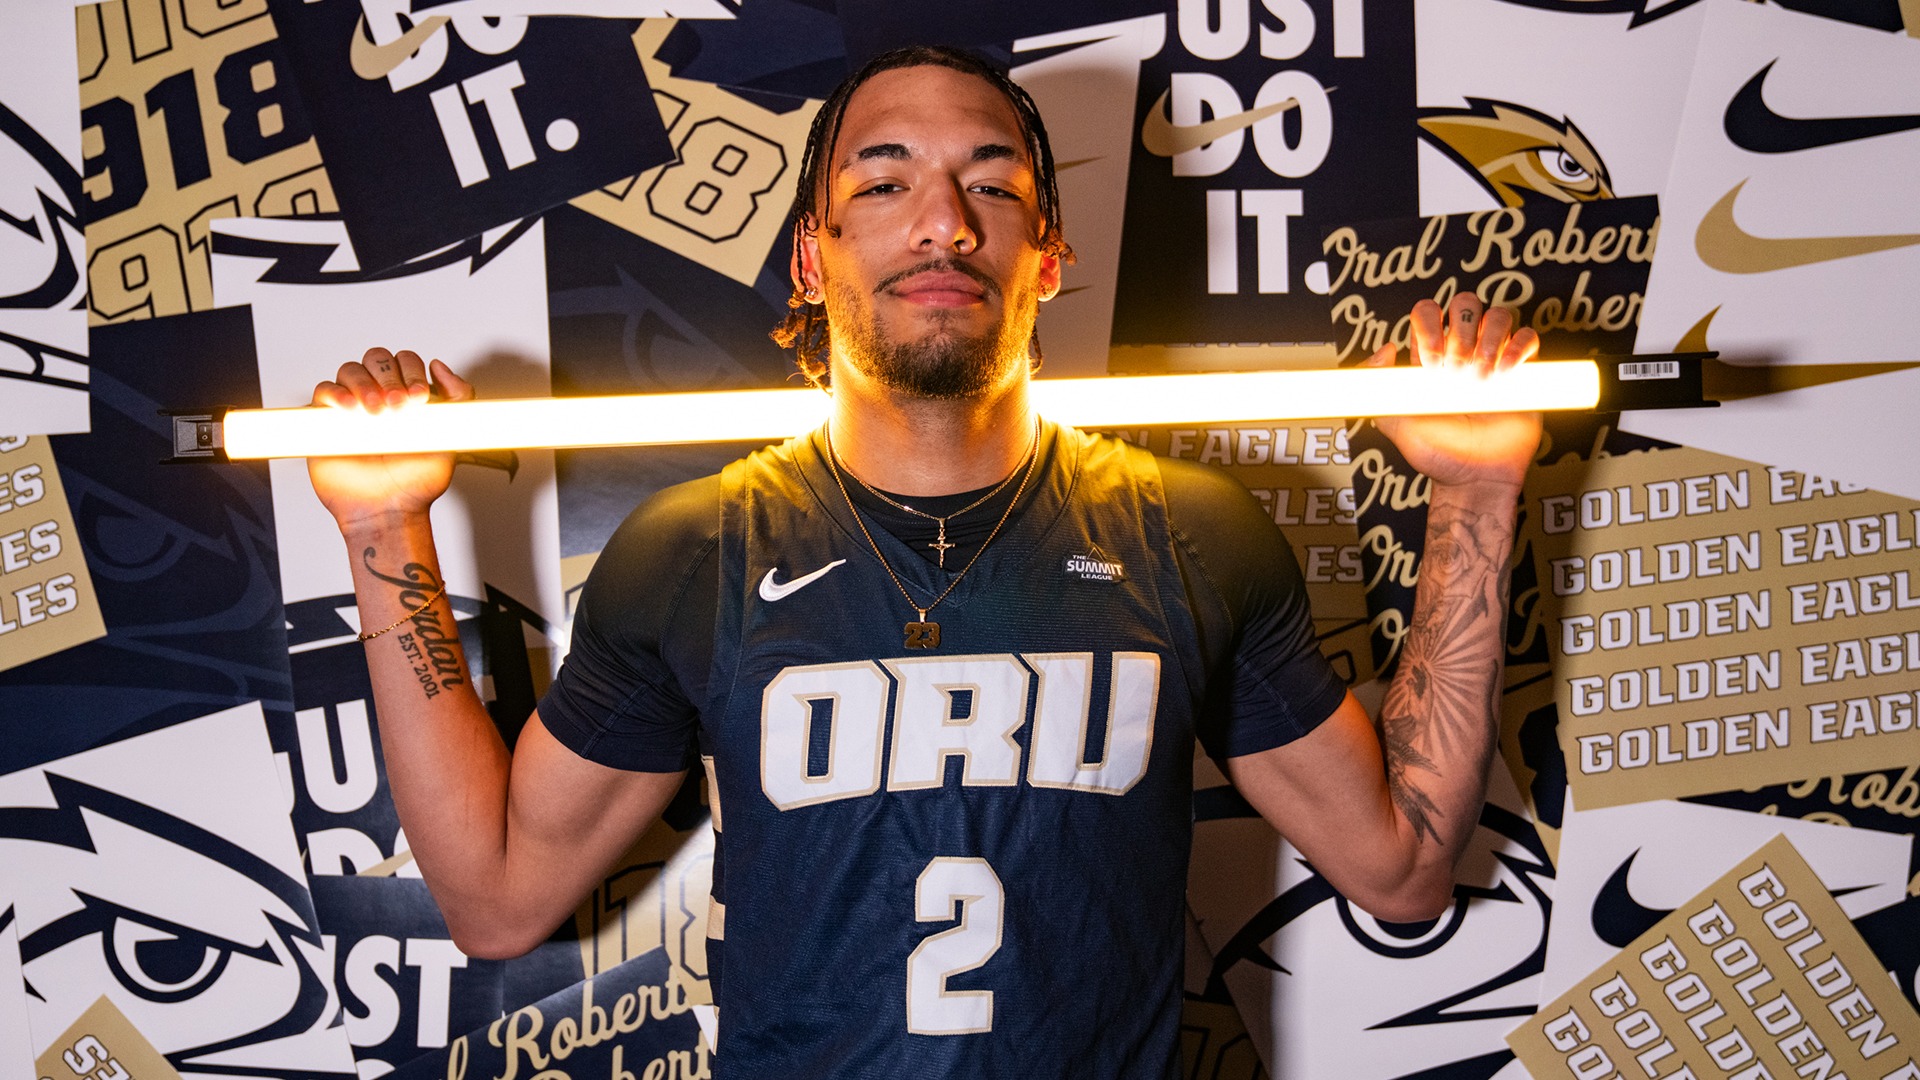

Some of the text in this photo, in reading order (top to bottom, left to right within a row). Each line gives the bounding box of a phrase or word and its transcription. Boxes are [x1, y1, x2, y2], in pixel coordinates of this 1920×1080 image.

[82, 43, 313, 225] 918
[429, 60, 579, 188] IT.
[1171, 70, 1333, 178] DO
[1323, 214, 1451, 295] Oral
[1539, 469, 1749, 535] GOLDEN
[1066, 560, 1123, 576] SUMMIT
[1549, 508, 1920, 597] GOLDEN EAGL
[363, 547, 464, 691] Jordan
[904, 622, 941, 649] 23
[1558, 588, 1772, 656] GOLDEN
[398, 632, 440, 699] EST. 2001
[1567, 650, 1781, 717] GOLDEN
[761, 652, 1161, 811] ORU
[1576, 708, 1790, 776] GOLDEN
[1806, 689, 1920, 744] EAG
[907, 857, 1005, 1036] 2
[1738, 862, 1899, 1060] GOLDEN
